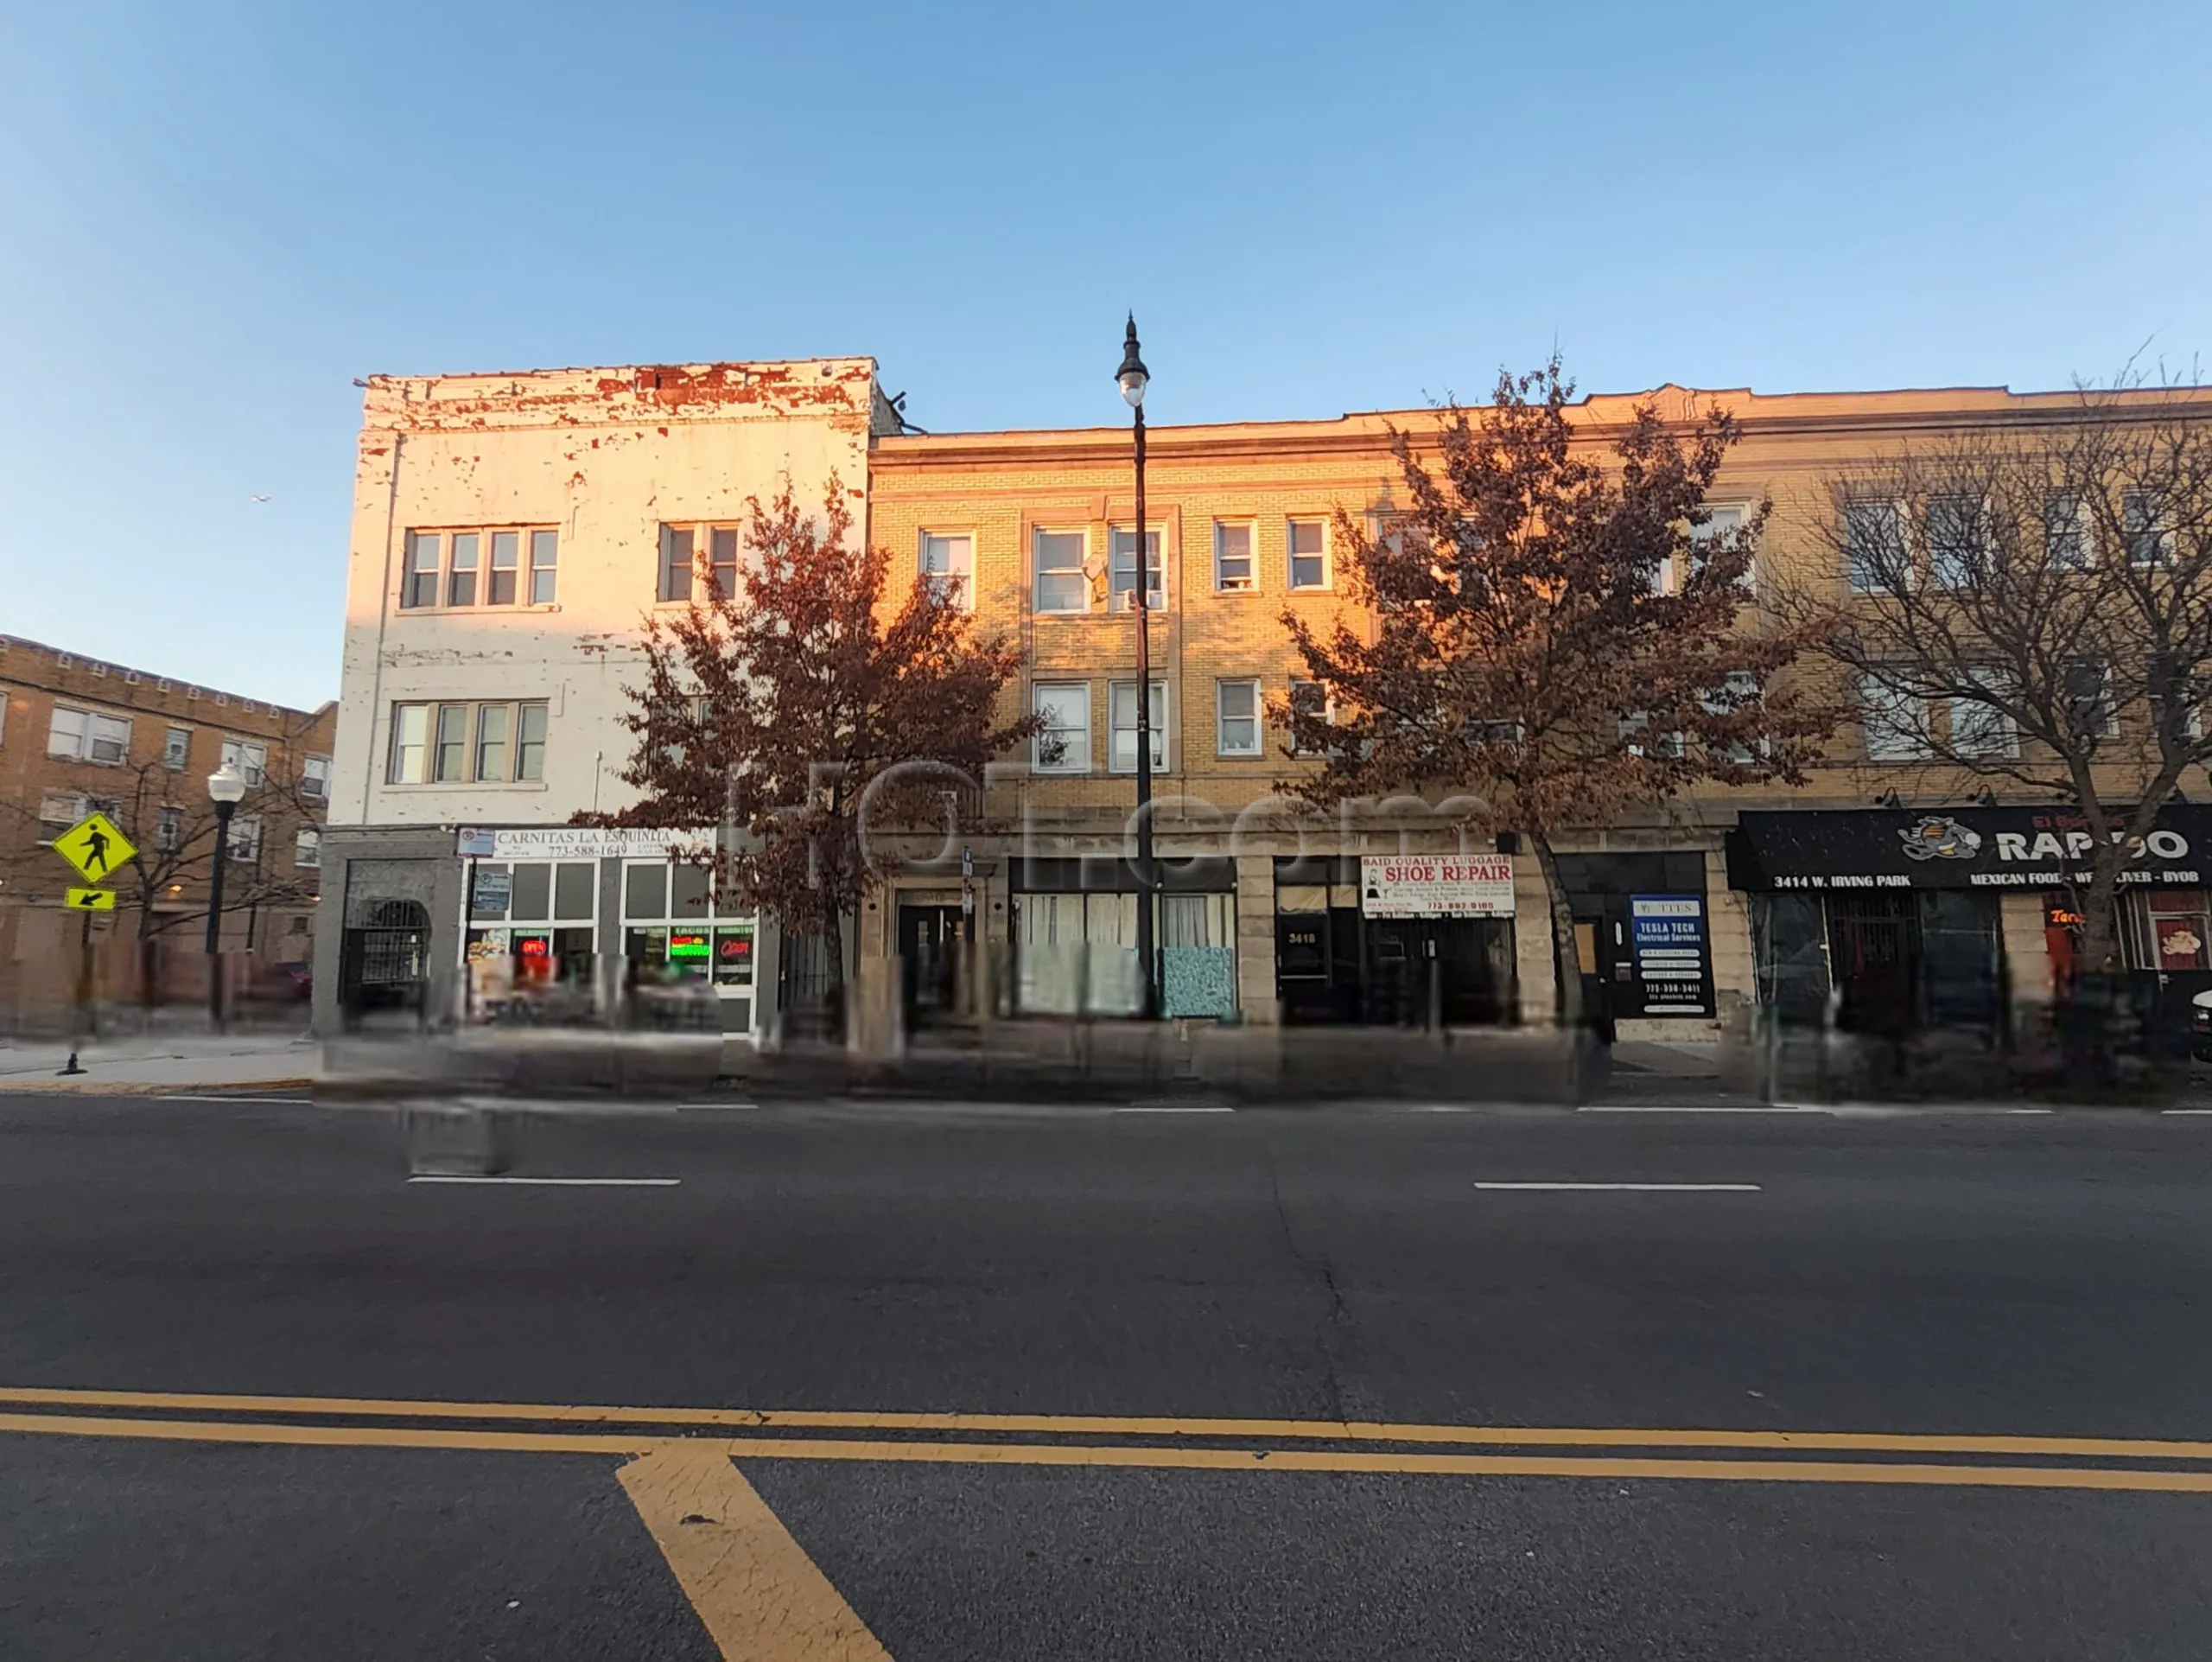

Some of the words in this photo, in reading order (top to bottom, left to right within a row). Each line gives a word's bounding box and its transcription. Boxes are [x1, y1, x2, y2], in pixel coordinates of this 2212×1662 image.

[498, 832, 575, 844] CARNITAS
[579, 831, 600, 844] LA
[1395, 856, 1448, 866] QUALITY
[1452, 855, 1511, 865] LUGGAGE
[1385, 866, 1435, 882] SHOE
[1441, 865, 1511, 881] REPAIR
[1970, 873, 2025, 886] MEXICAN
[2163, 870, 2200, 882] BYOB
[1774, 876, 1808, 888] 3414
[1811, 876, 1828, 888] W.
[1831, 875, 1873, 888] IRVING
[1876, 875, 1911, 887] PARK
[1640, 922, 1669, 933] TESLA
[1672, 922, 1695, 933] TECH
